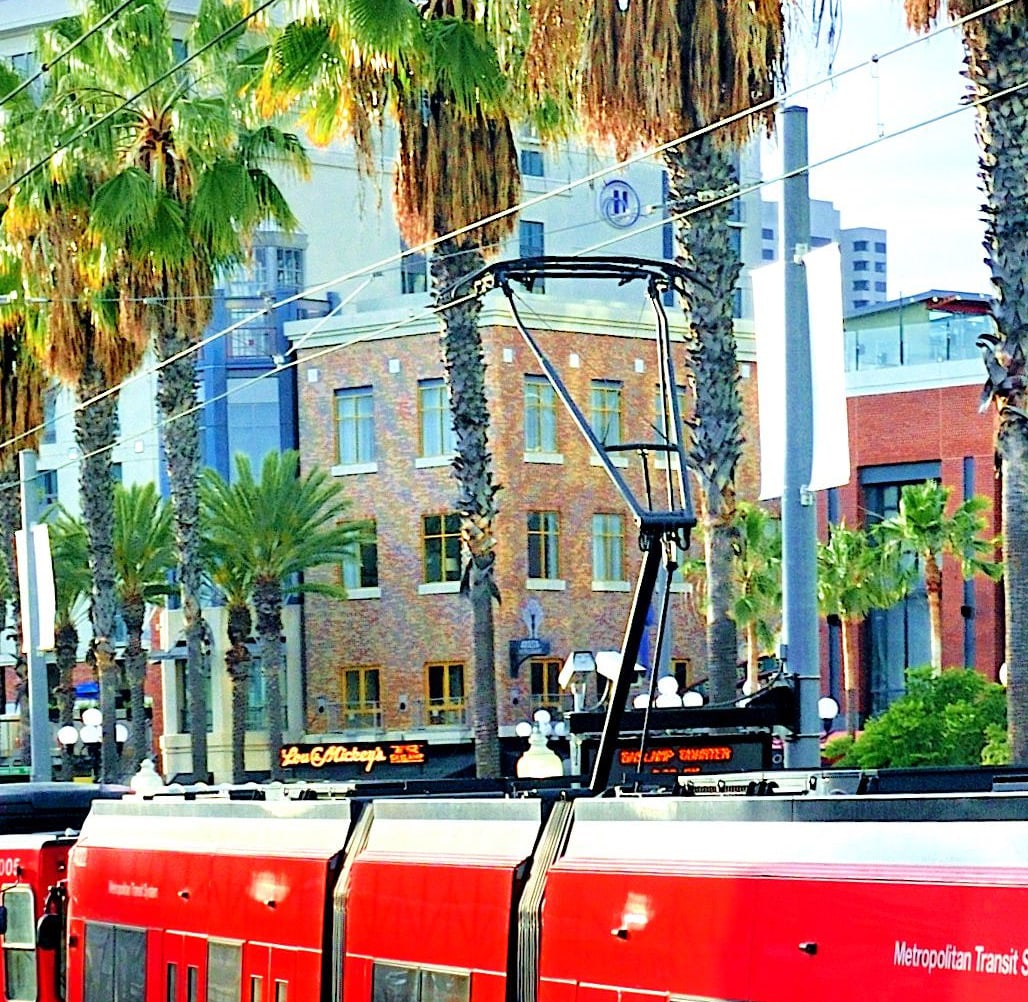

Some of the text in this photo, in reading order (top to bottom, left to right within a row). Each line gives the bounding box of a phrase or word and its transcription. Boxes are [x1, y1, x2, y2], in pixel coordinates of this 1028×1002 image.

[322, 745, 387, 773] Mickey's
[893, 940, 972, 974] Metropolitan
[975, 945, 1018, 976] Transit
